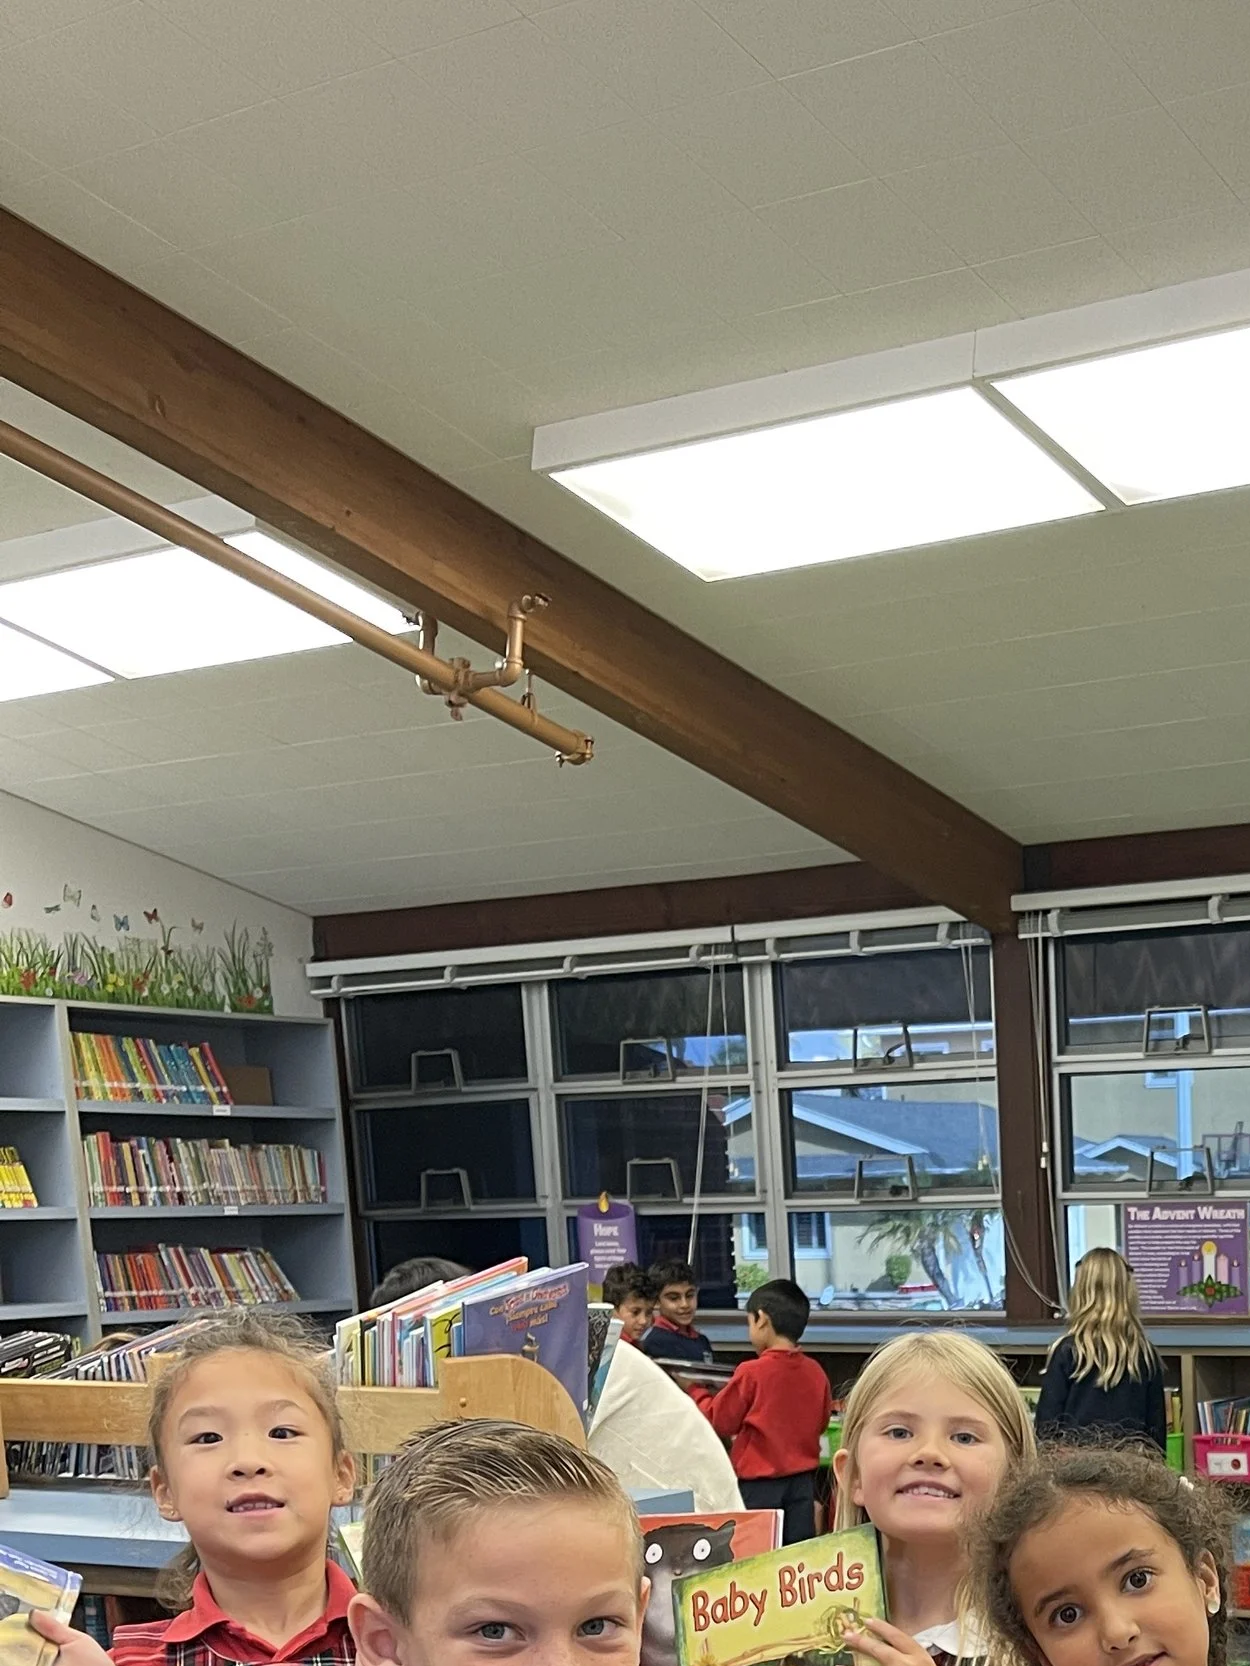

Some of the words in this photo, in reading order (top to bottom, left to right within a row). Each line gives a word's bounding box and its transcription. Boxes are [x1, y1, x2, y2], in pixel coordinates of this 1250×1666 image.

[1127, 1206, 1150, 1221] THE
[1150, 1206, 1195, 1221] ADVENT
[1197, 1206, 1245, 1220] WREATH
[692, 1581, 768, 1632] Baby
[779, 1551, 864, 1608] Birds
